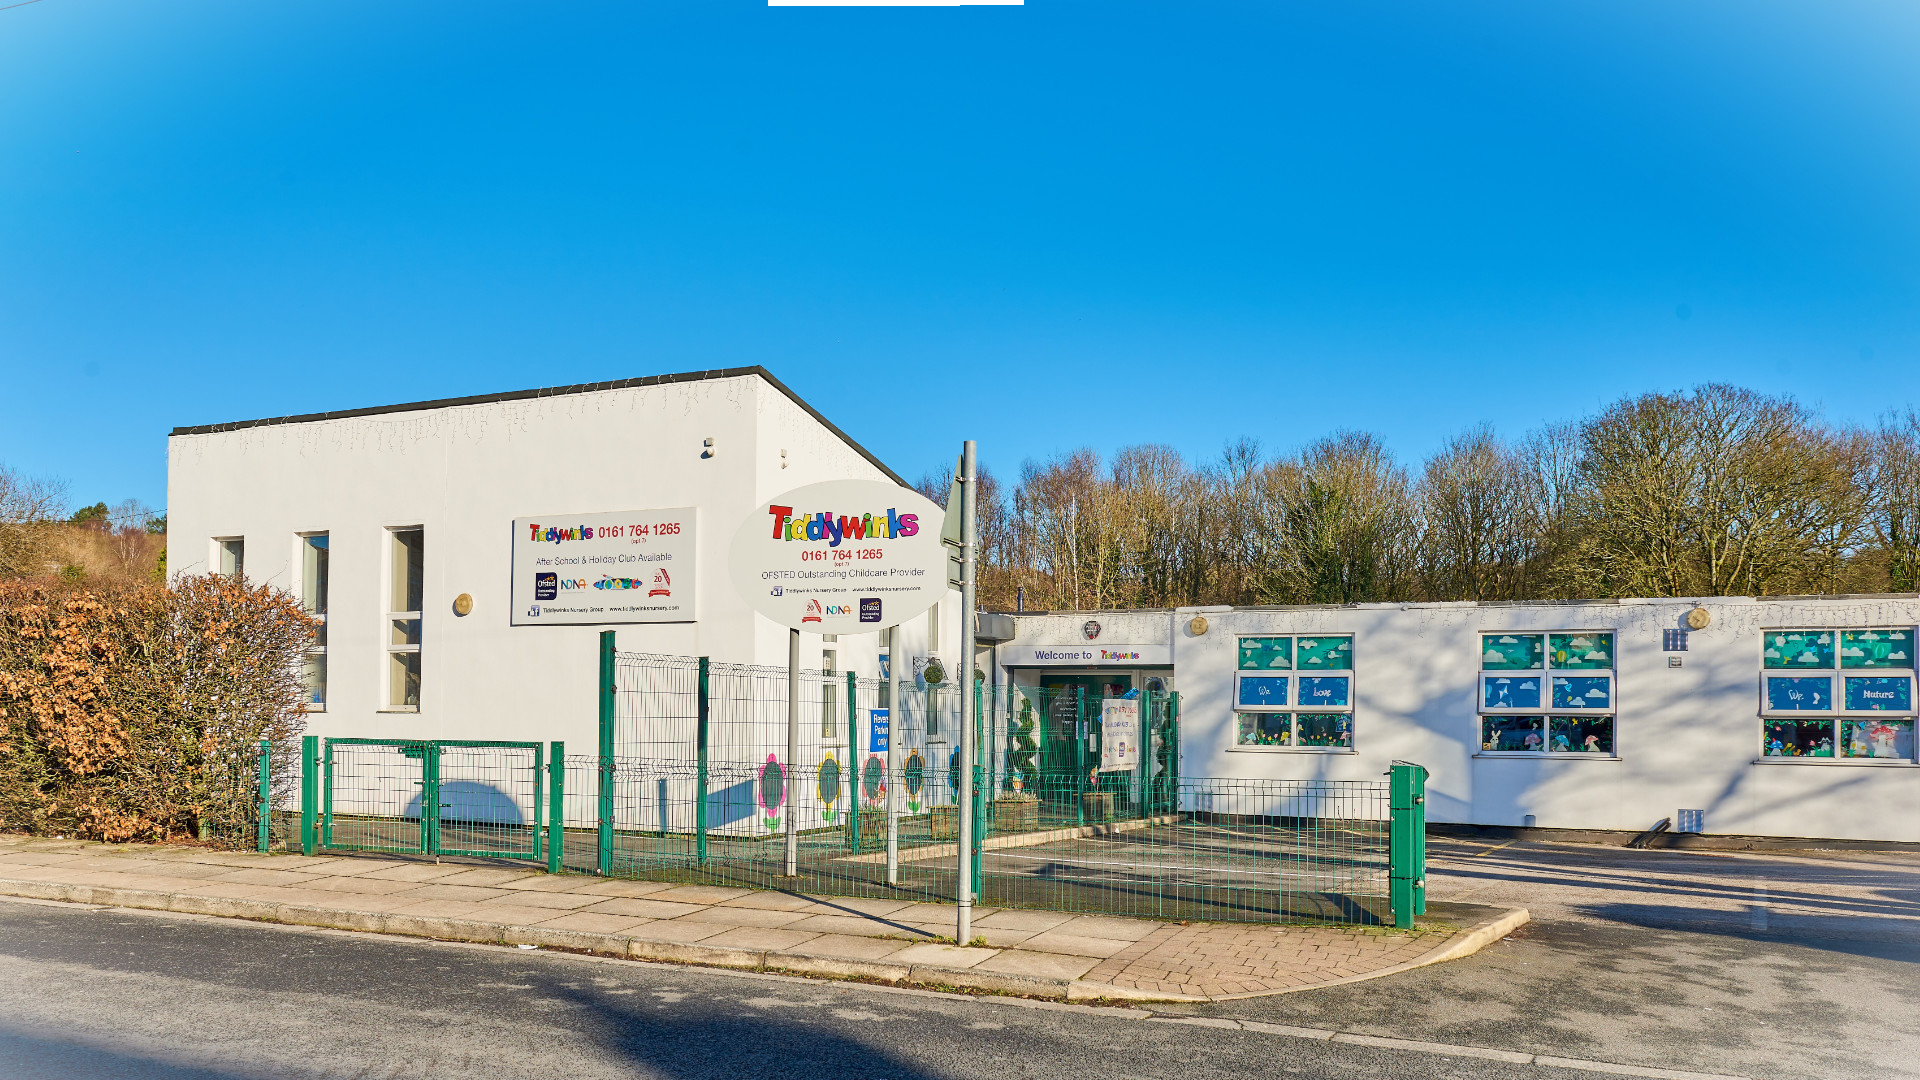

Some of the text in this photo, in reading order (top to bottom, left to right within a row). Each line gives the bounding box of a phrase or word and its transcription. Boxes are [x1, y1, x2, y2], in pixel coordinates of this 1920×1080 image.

[598, 522, 681, 538] 0161 764 1265
[769, 504, 919, 547] Tiddlywinks
[529, 523, 594, 545] Tiddlywinks
[536, 552, 673, 566] After School & Holiday Club Available
[801, 549, 883, 561] 0161 764 1265
[761, 567, 925, 580] OFSTED Outstanding Childcare Provider
[1034, 650, 1079, 660] Welcome
[1082, 651, 1092, 660] to
[874, 725, 889, 735] Parkin
